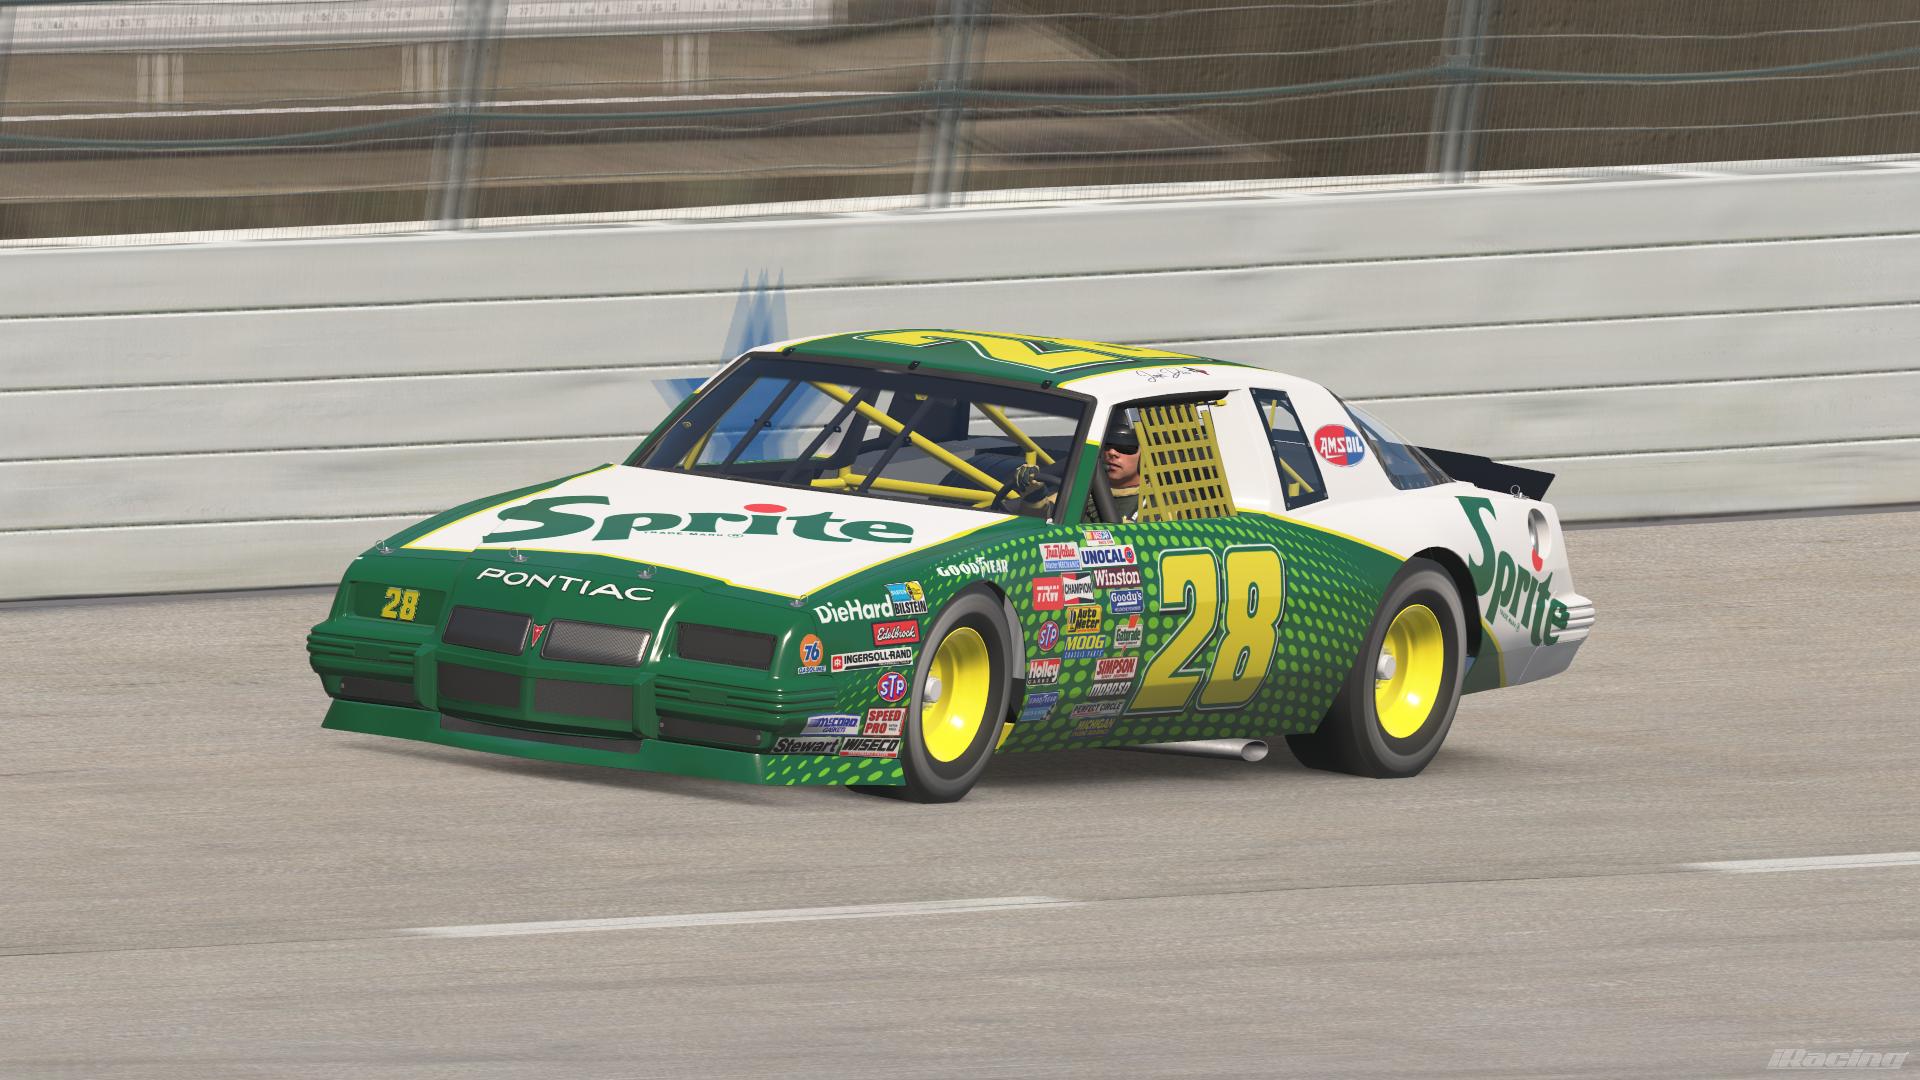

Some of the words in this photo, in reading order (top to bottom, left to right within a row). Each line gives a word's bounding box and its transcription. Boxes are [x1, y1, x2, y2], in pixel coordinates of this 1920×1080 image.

[1320, 436, 1363, 457] AMSOIL
[482, 496, 914, 544] Sprite
[1081, 548, 1126, 564] UNOCAL
[936, 557, 1009, 577] GOODYEAR
[1455, 495, 1570, 646] Sprite
[476, 567, 654, 601] PONTIAC
[1094, 566, 1140, 586] Winston
[1064, 582, 1092, 595] CHAMPION
[381, 586, 421, 621] 28
[1111, 590, 1142, 606] Goody's
[813, 594, 894, 624] DieHard
[894, 600, 927, 615] BILSTEIN
[1078, 608, 1097, 619] Auto
[1076, 619, 1100, 629] Meter
[1122, 544, 1287, 715] 28
[877, 625, 916, 641] Edelbrock
[1040, 624, 1057, 648] STP
[1116, 628, 1141, 642] Gatorade
[1065, 635, 1106, 651] MOOG
[804, 643, 820, 661] 76
[844, 649, 912, 664] INGERSOLL-RAND
[1028, 660, 1060, 682] Holley
[1096, 658, 1135, 675] SIMPSON
[880, 674, 904, 698] STP
[868, 710, 901, 722] SPEED
[865, 723, 887, 734] PRO
[774, 738, 839, 753] Stewart
[842, 738, 900, 752] WISECO
